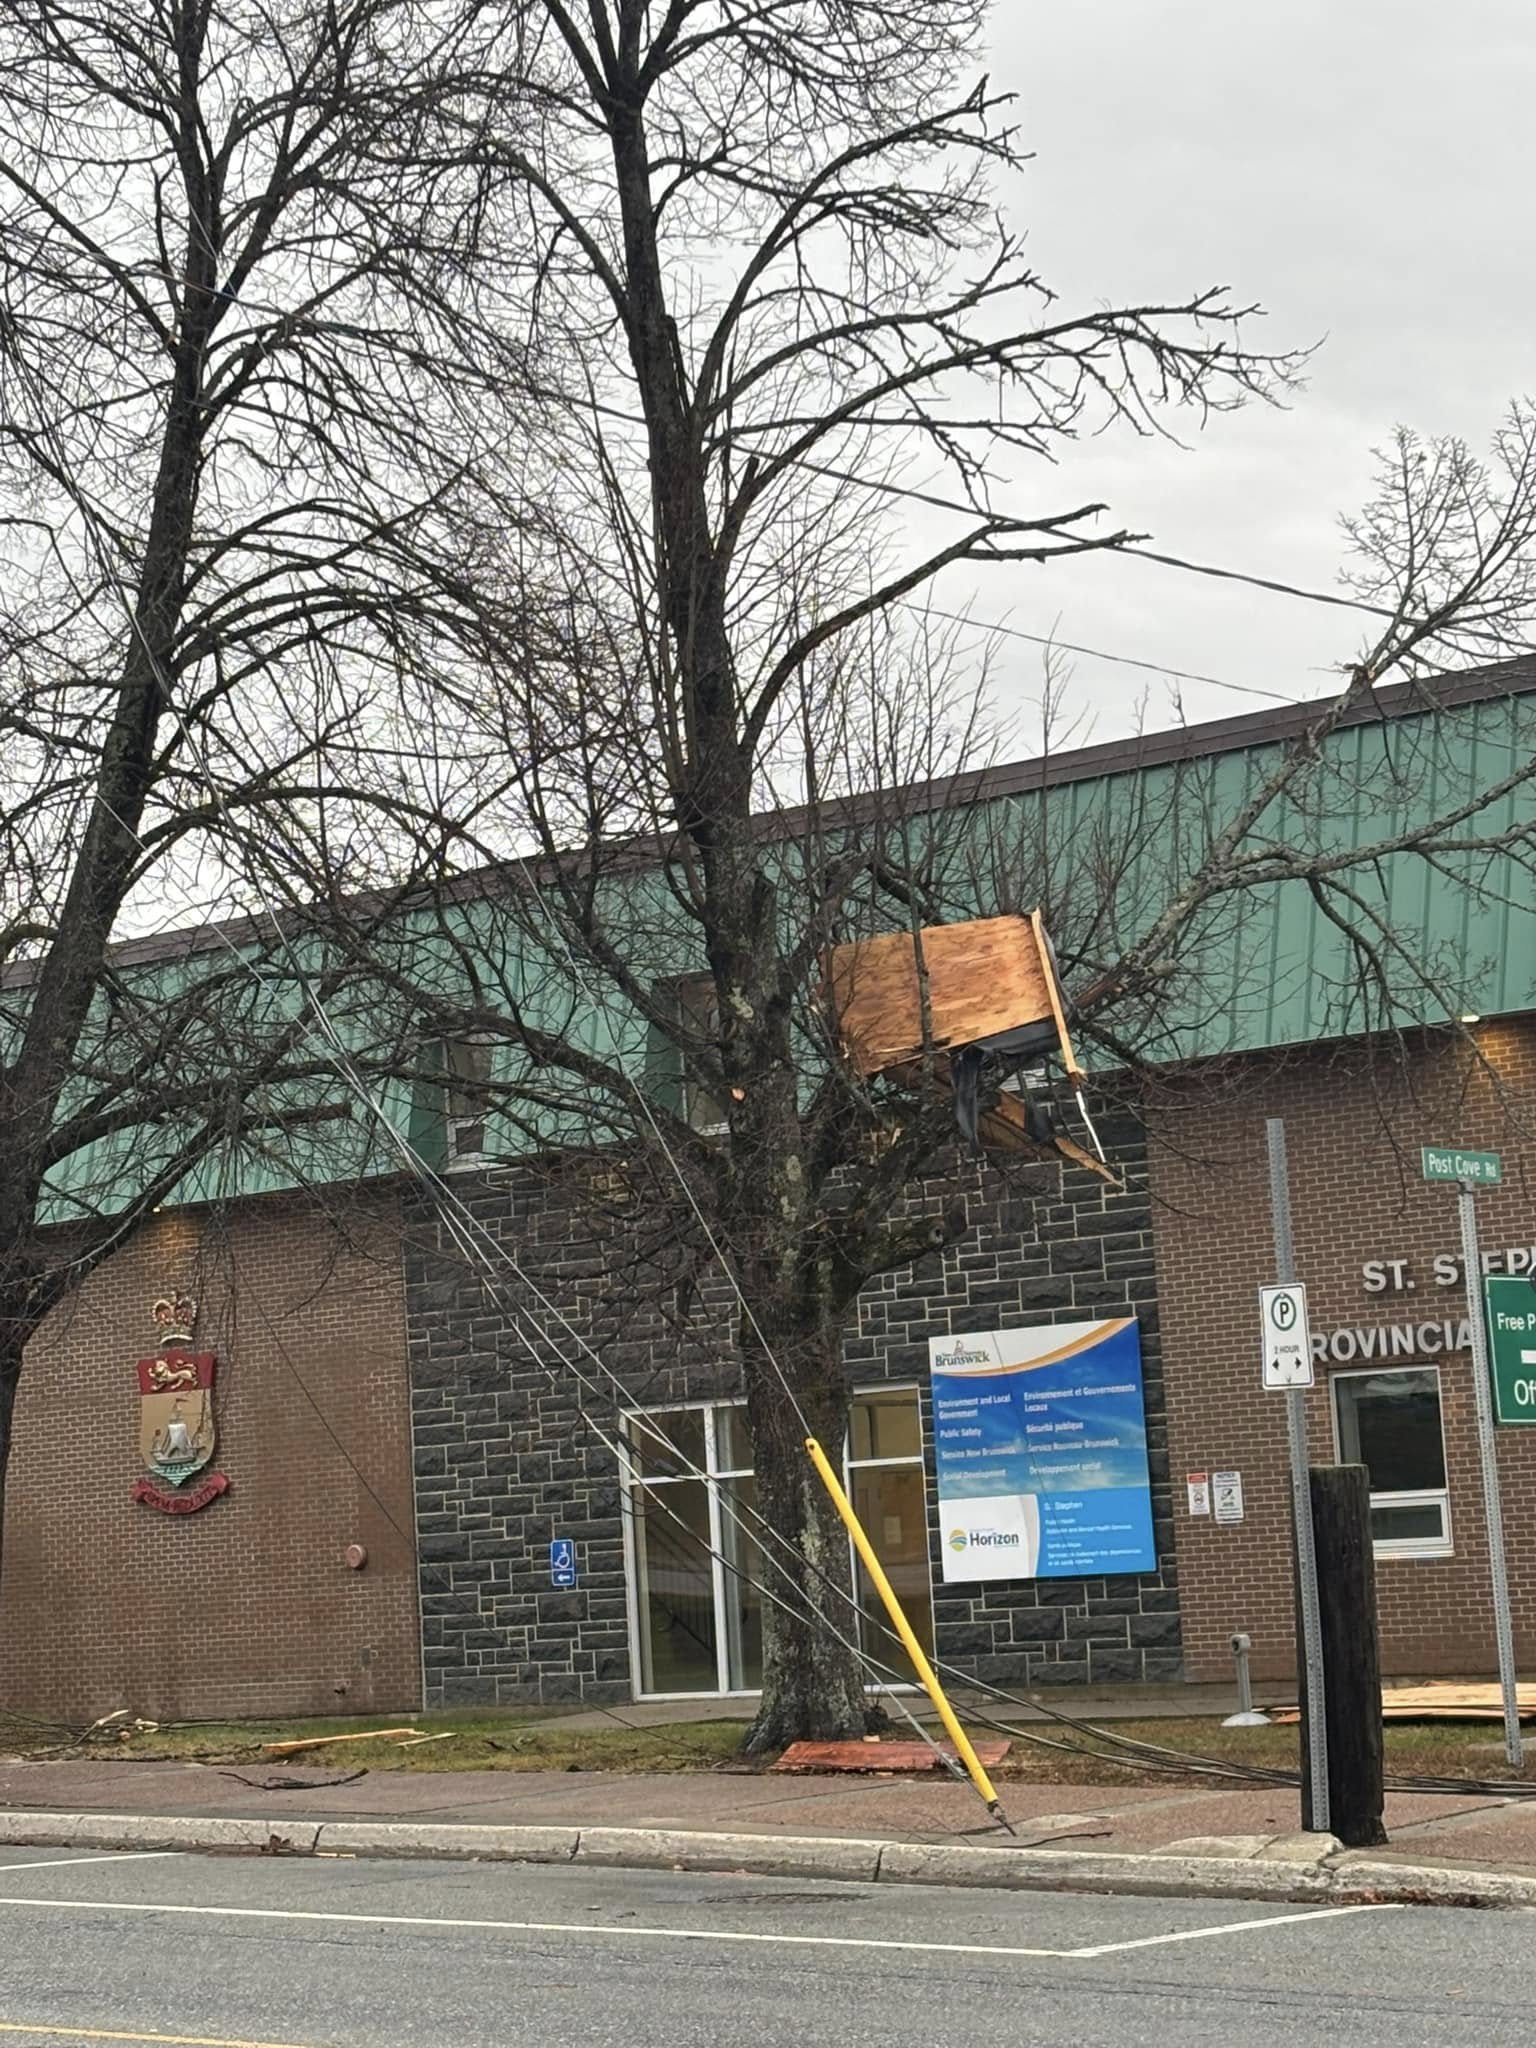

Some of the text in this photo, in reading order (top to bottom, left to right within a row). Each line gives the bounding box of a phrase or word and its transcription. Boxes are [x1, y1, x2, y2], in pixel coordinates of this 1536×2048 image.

[1428, 1153, 1453, 1174] Post
[1455, 1155, 1481, 1177] Cove
[1362, 1246, 1536, 1292] ST. SEP
[1280, 1301, 1290, 1325] P
[1497, 1312, 1525, 1331] Free
[1311, 1318, 1475, 1362] ROVINCIA
[936, 1350, 990, 1367] Brunswick
[993, 1392, 1011, 1404] Local
[1074, 1387, 1082, 1397] et
[1514, 1379, 1536, 1405] Of
[961, 1427, 982, 1439] Safety
[969, 1532, 1019, 1547] Horizon
